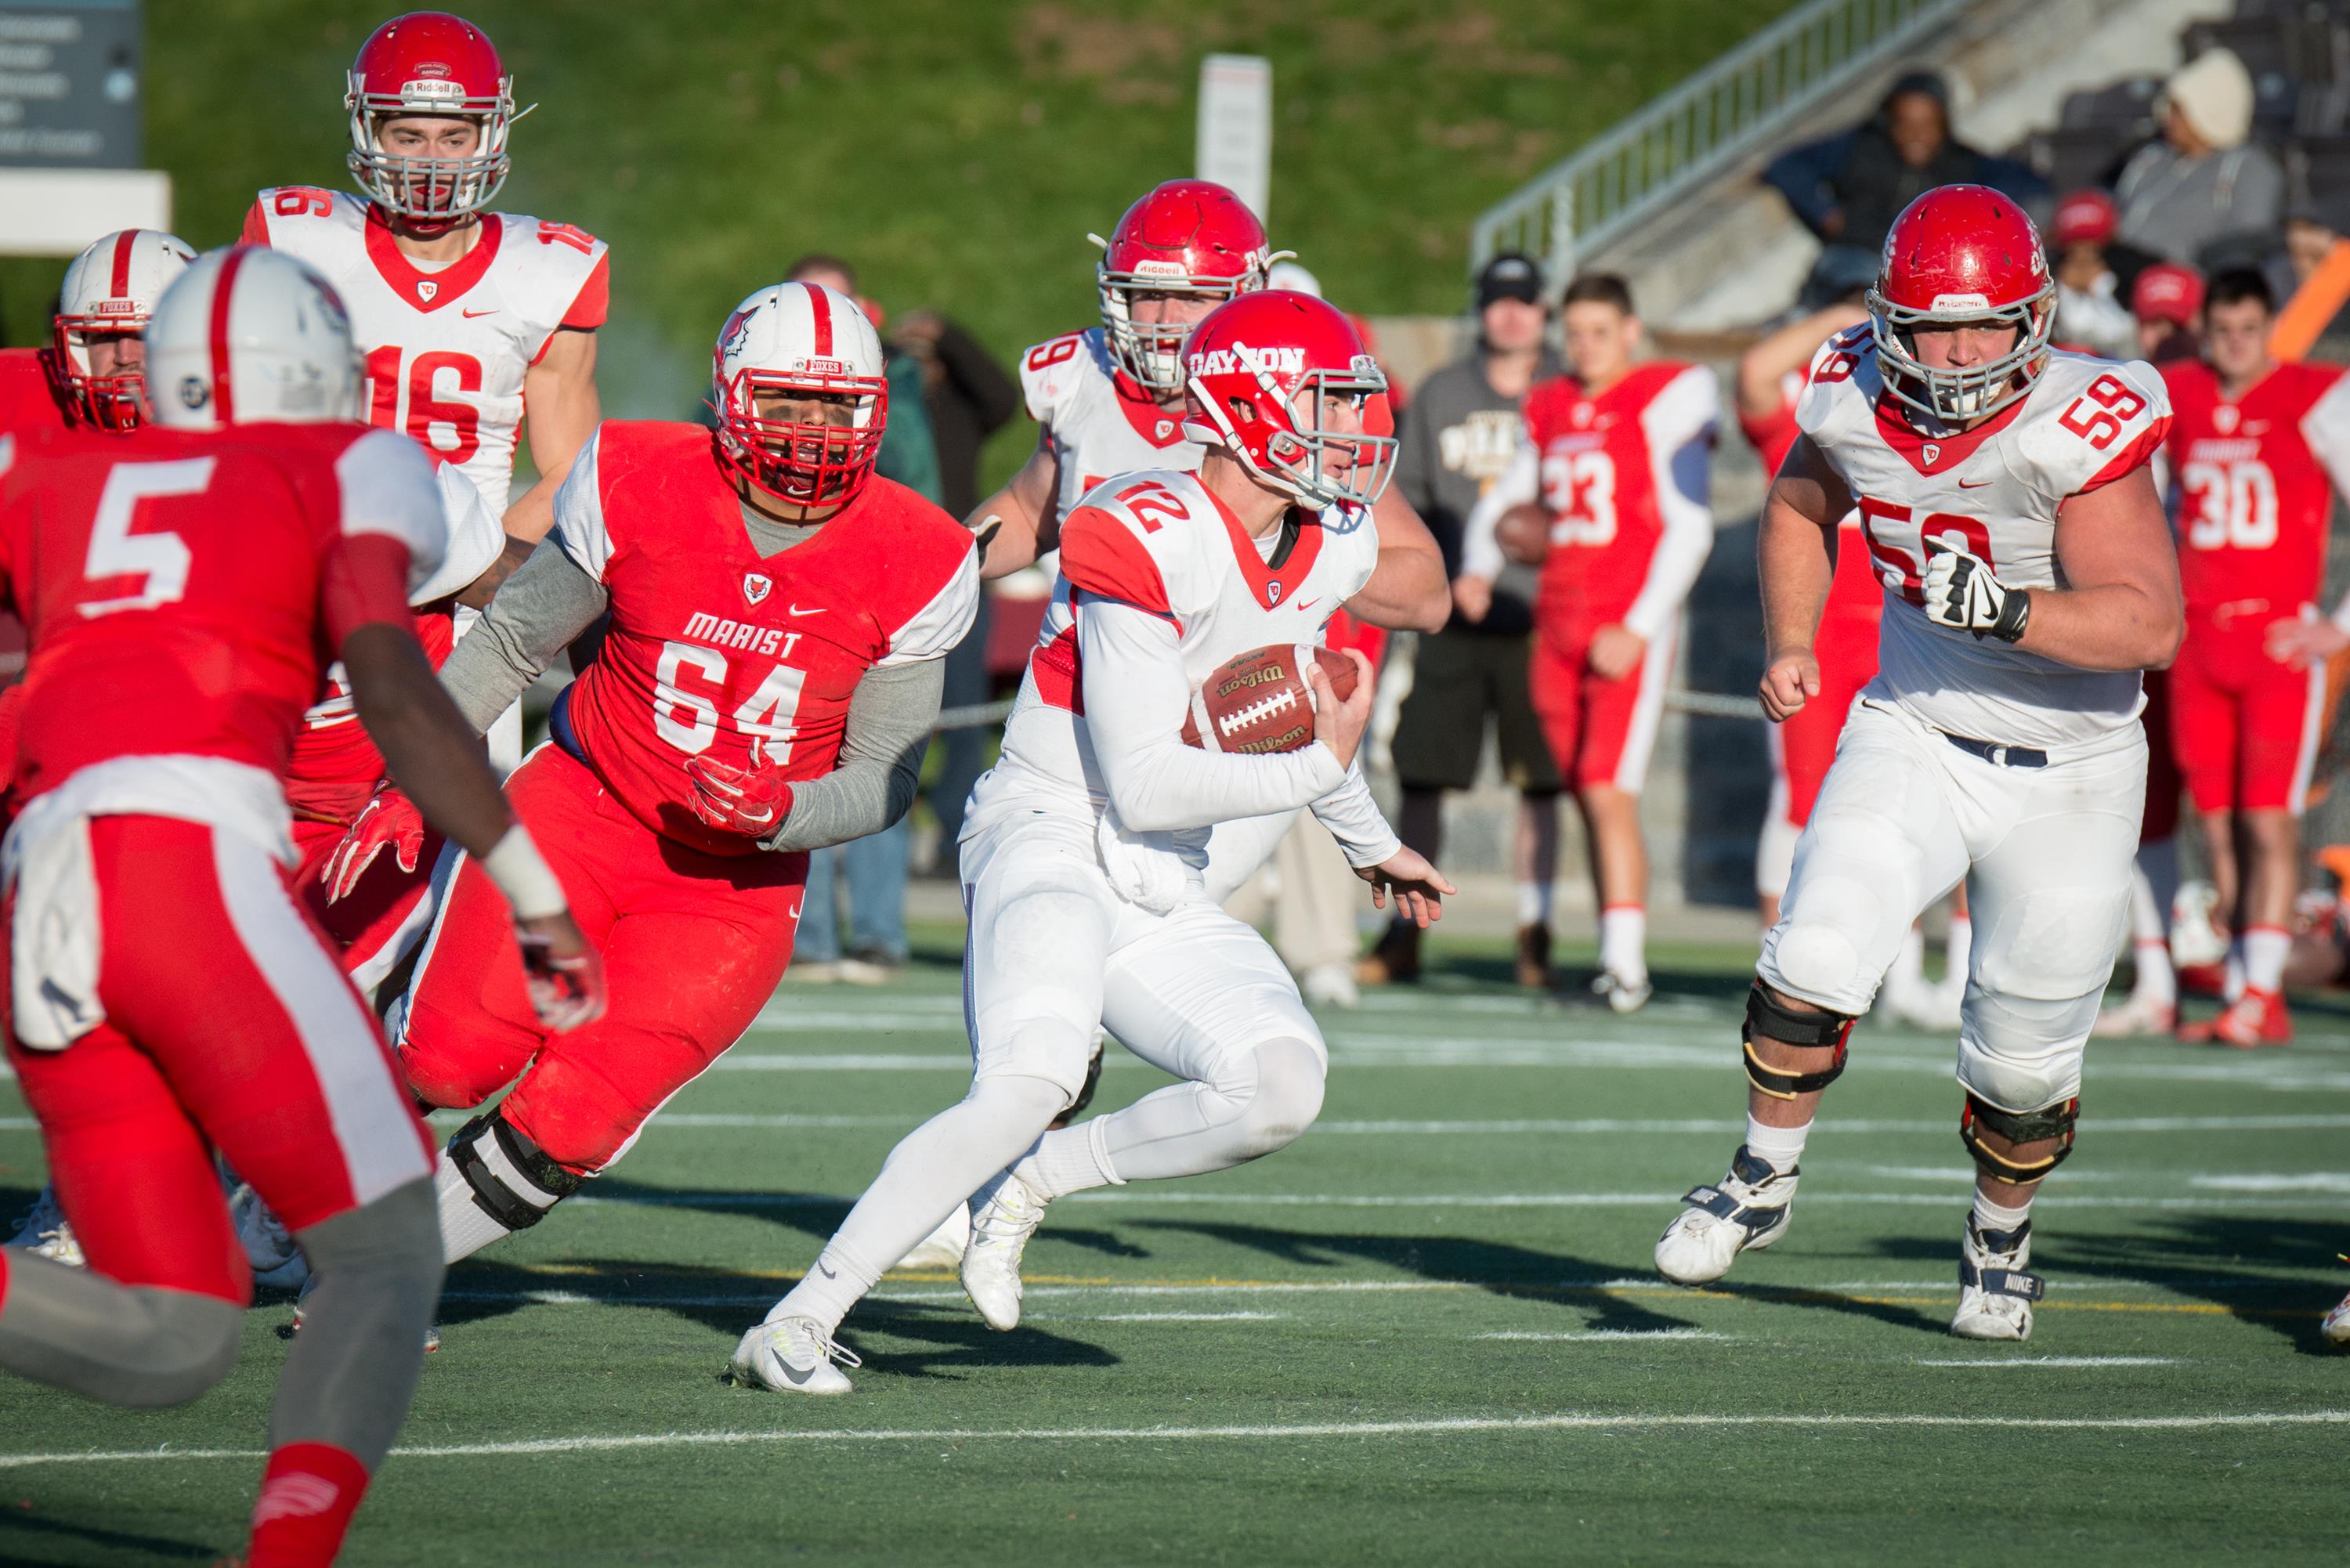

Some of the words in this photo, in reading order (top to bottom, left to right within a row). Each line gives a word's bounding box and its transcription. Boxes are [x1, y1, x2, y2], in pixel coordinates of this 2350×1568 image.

[417, 82, 450, 92] Riddell
[363, 345, 483, 464] 16
[2057, 374, 2147, 450] 59
[1113, 480, 1191, 534] 12
[2182, 461, 2279, 550] 30
[76, 455, 218, 620] 5
[683, 612, 803, 659] MARIST
[653, 641, 807, 765] 64
[1217, 665, 1285, 697] Wilson
[1238, 725, 1308, 754] Wilson
[1689, 1187, 1719, 1205] NIKE
[2005, 1273, 2034, 1294] NIKE
